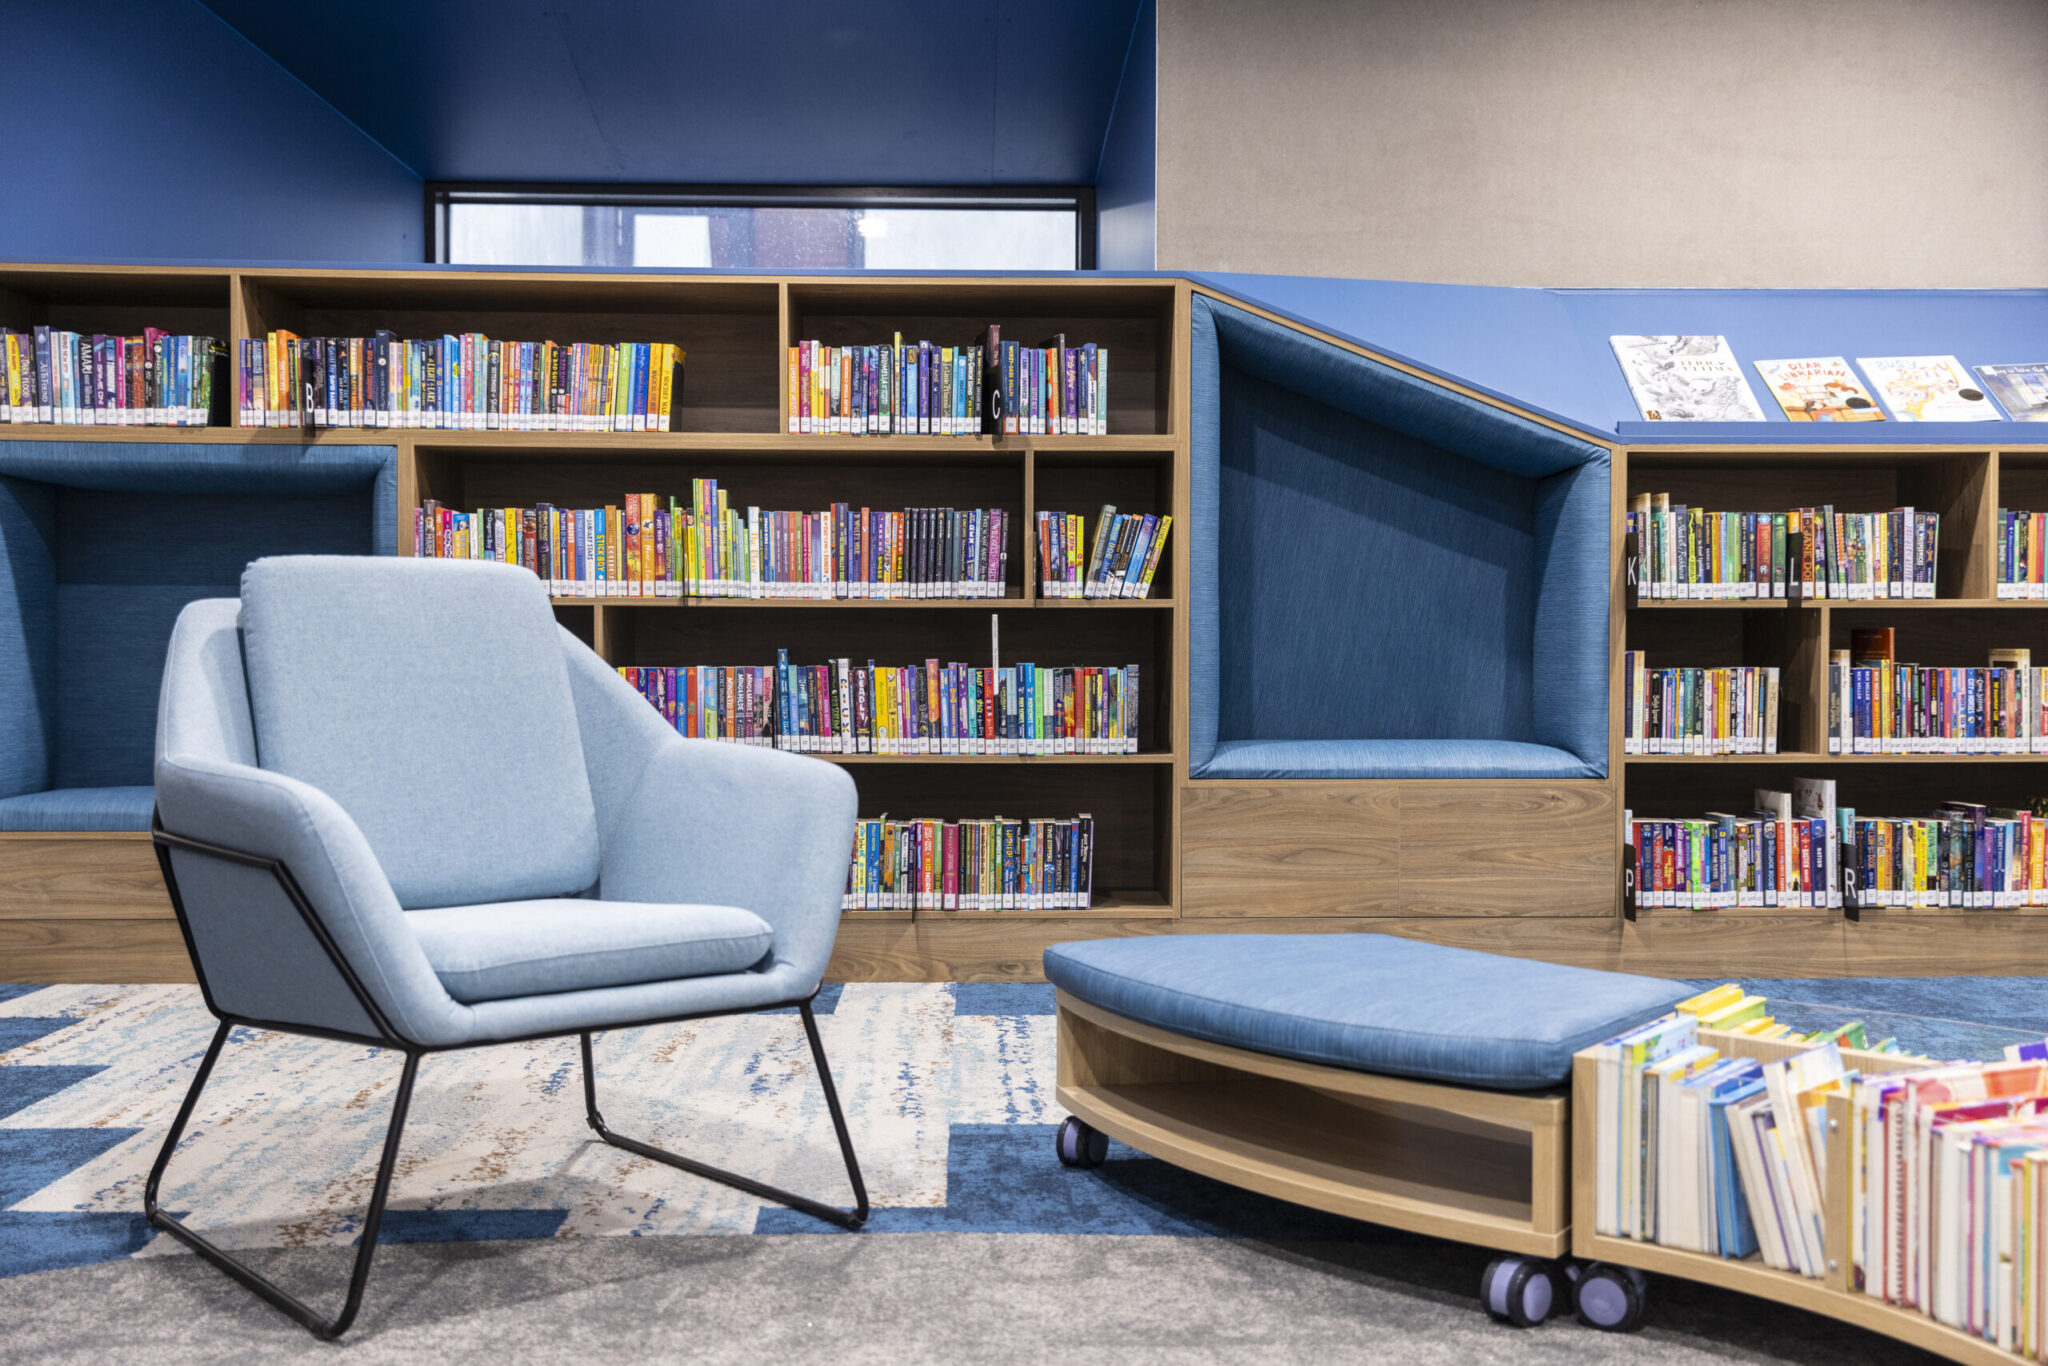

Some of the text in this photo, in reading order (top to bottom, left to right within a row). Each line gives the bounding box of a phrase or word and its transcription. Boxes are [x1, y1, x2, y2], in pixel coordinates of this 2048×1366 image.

[81, 343, 92, 374] AMARI
[1788, 361, 1821, 371] DEAR
[427, 363, 435, 403] LIGHT LAKE
[1778, 370, 1846, 381] LIBRARIAN
[98, 391, 104, 405] ON
[306, 383, 314, 413] B
[992, 389, 1001, 420] C
[597, 534, 605, 572] STICK BOY
[1106, 543, 1115, 559] DOG
[1803, 531, 1812, 559] JANE
[1628, 557, 1637, 586] K
[1790, 557, 1799, 586] L
[1967, 678, 1975, 690] CITY
[1928, 825, 1936, 848] ALIYA
[1626, 868, 1634, 897] P
[1845, 868, 1857, 899] R
